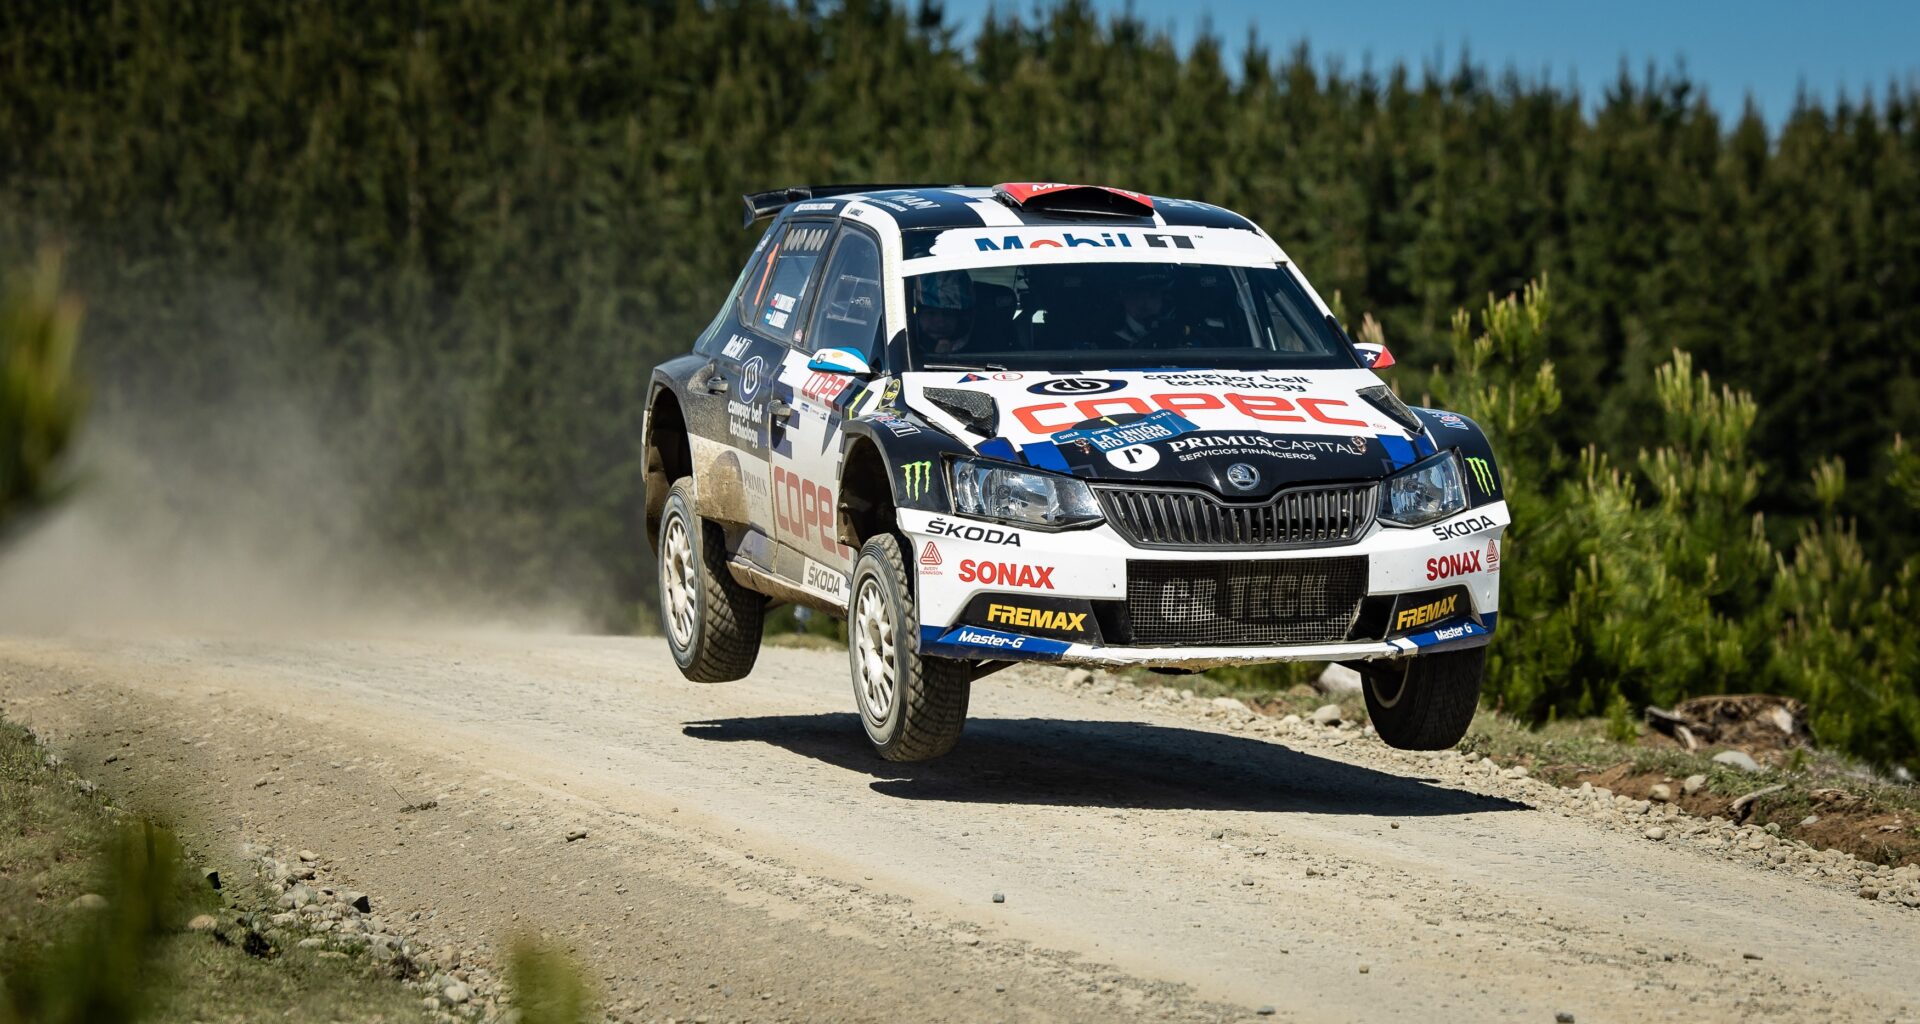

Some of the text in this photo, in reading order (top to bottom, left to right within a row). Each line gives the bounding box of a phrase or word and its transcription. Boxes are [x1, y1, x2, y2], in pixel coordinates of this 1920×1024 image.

[754, 243, 779, 305] 1
[1143, 373, 1313, 384] conveyor belt
[1164, 379, 1307, 393] technology
[751, 402, 763, 424] belt
[729, 415, 758, 449] technology
[1058, 431, 1080, 440] CHILE
[1090, 434, 1114, 446] LA
[1124, 431, 1173, 443] BUENO
[1178, 448, 1316, 462] SERVICIOS FINANCIEROS
[925, 517, 1021, 547] ŠKODA
[1432, 515, 1497, 541] ŠKODA
[958, 559, 1055, 590] SONAX
[1426, 549, 1482, 581] SONAX
[1228, 574, 1328, 620] TECH
[987, 603, 1088, 632] FREMAX
[1396, 594, 1458, 631] FREMAX
[958, 630, 1026, 649] Master-G
